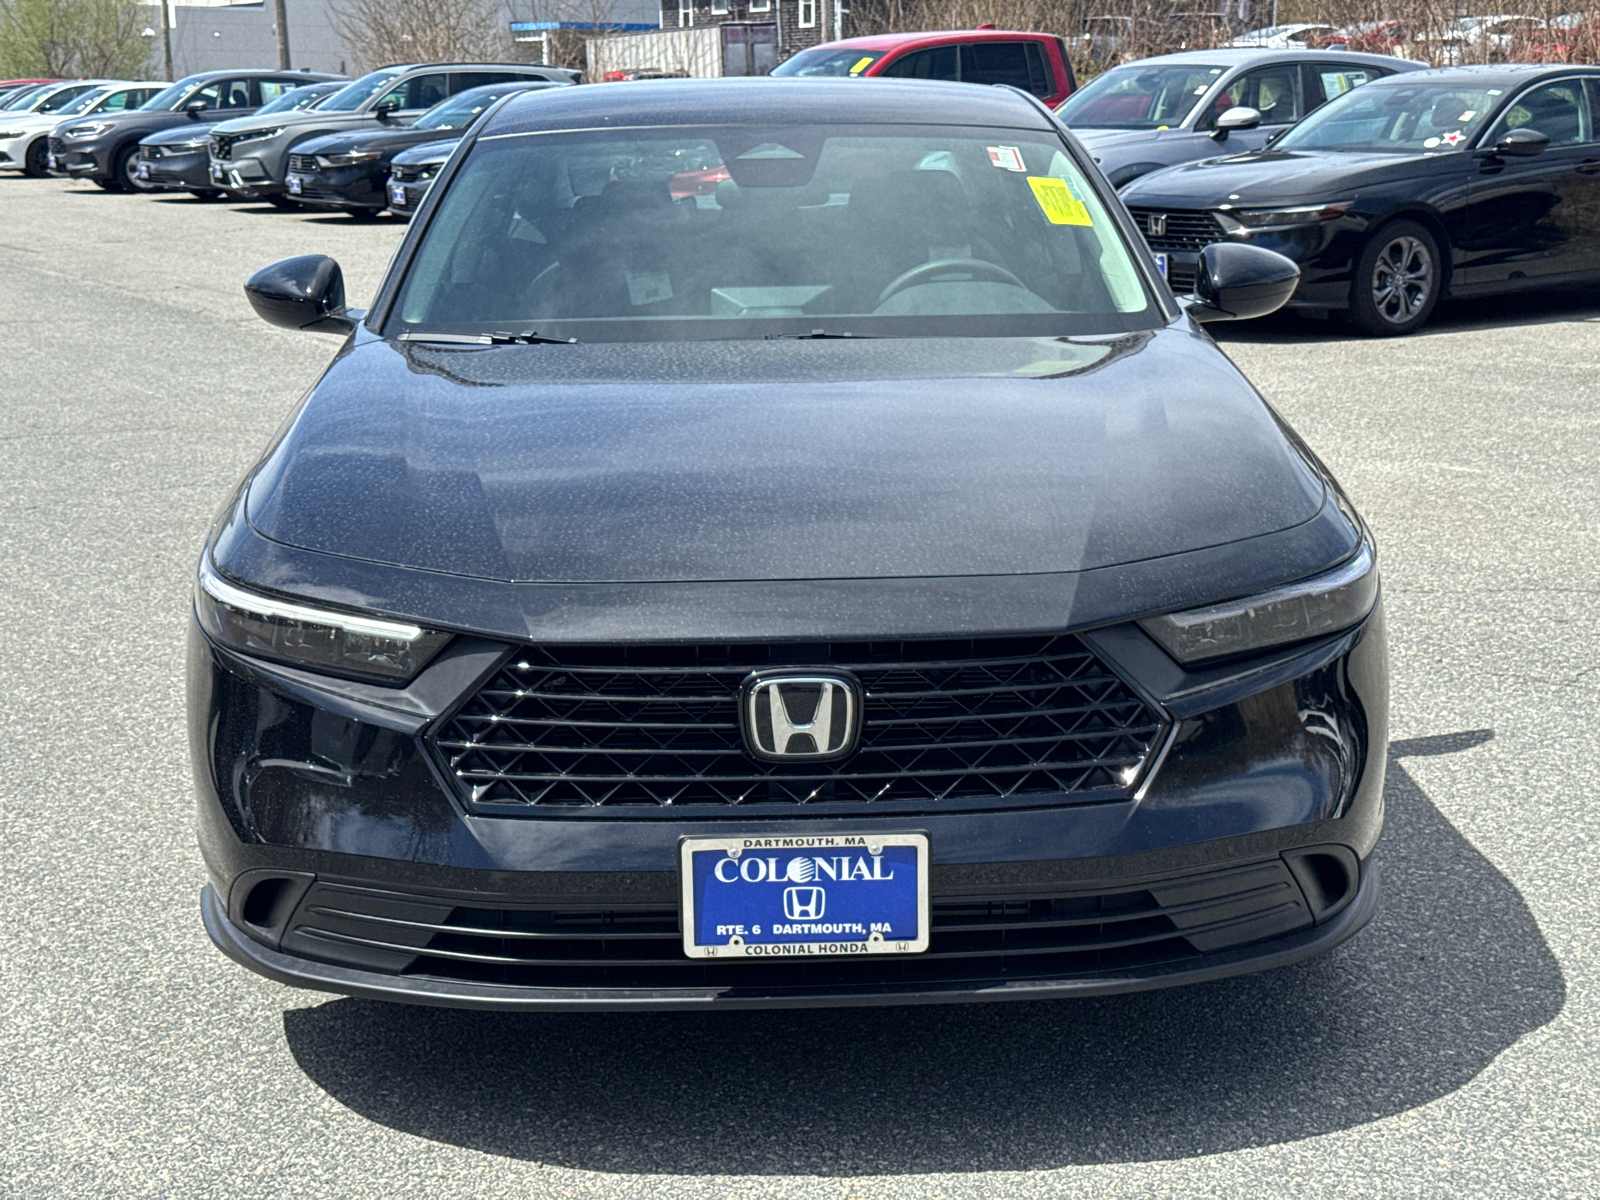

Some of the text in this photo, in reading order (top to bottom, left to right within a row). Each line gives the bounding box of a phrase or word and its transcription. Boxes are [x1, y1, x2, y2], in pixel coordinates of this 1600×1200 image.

[743, 837, 866, 848] DARTMOUTH, MA
[714, 855, 894, 883] COLONIAL
[716, 922, 892, 936] RTE. 6 DARTMOUTH, MA
[745, 942, 869, 956] COLONIAL HONDA
